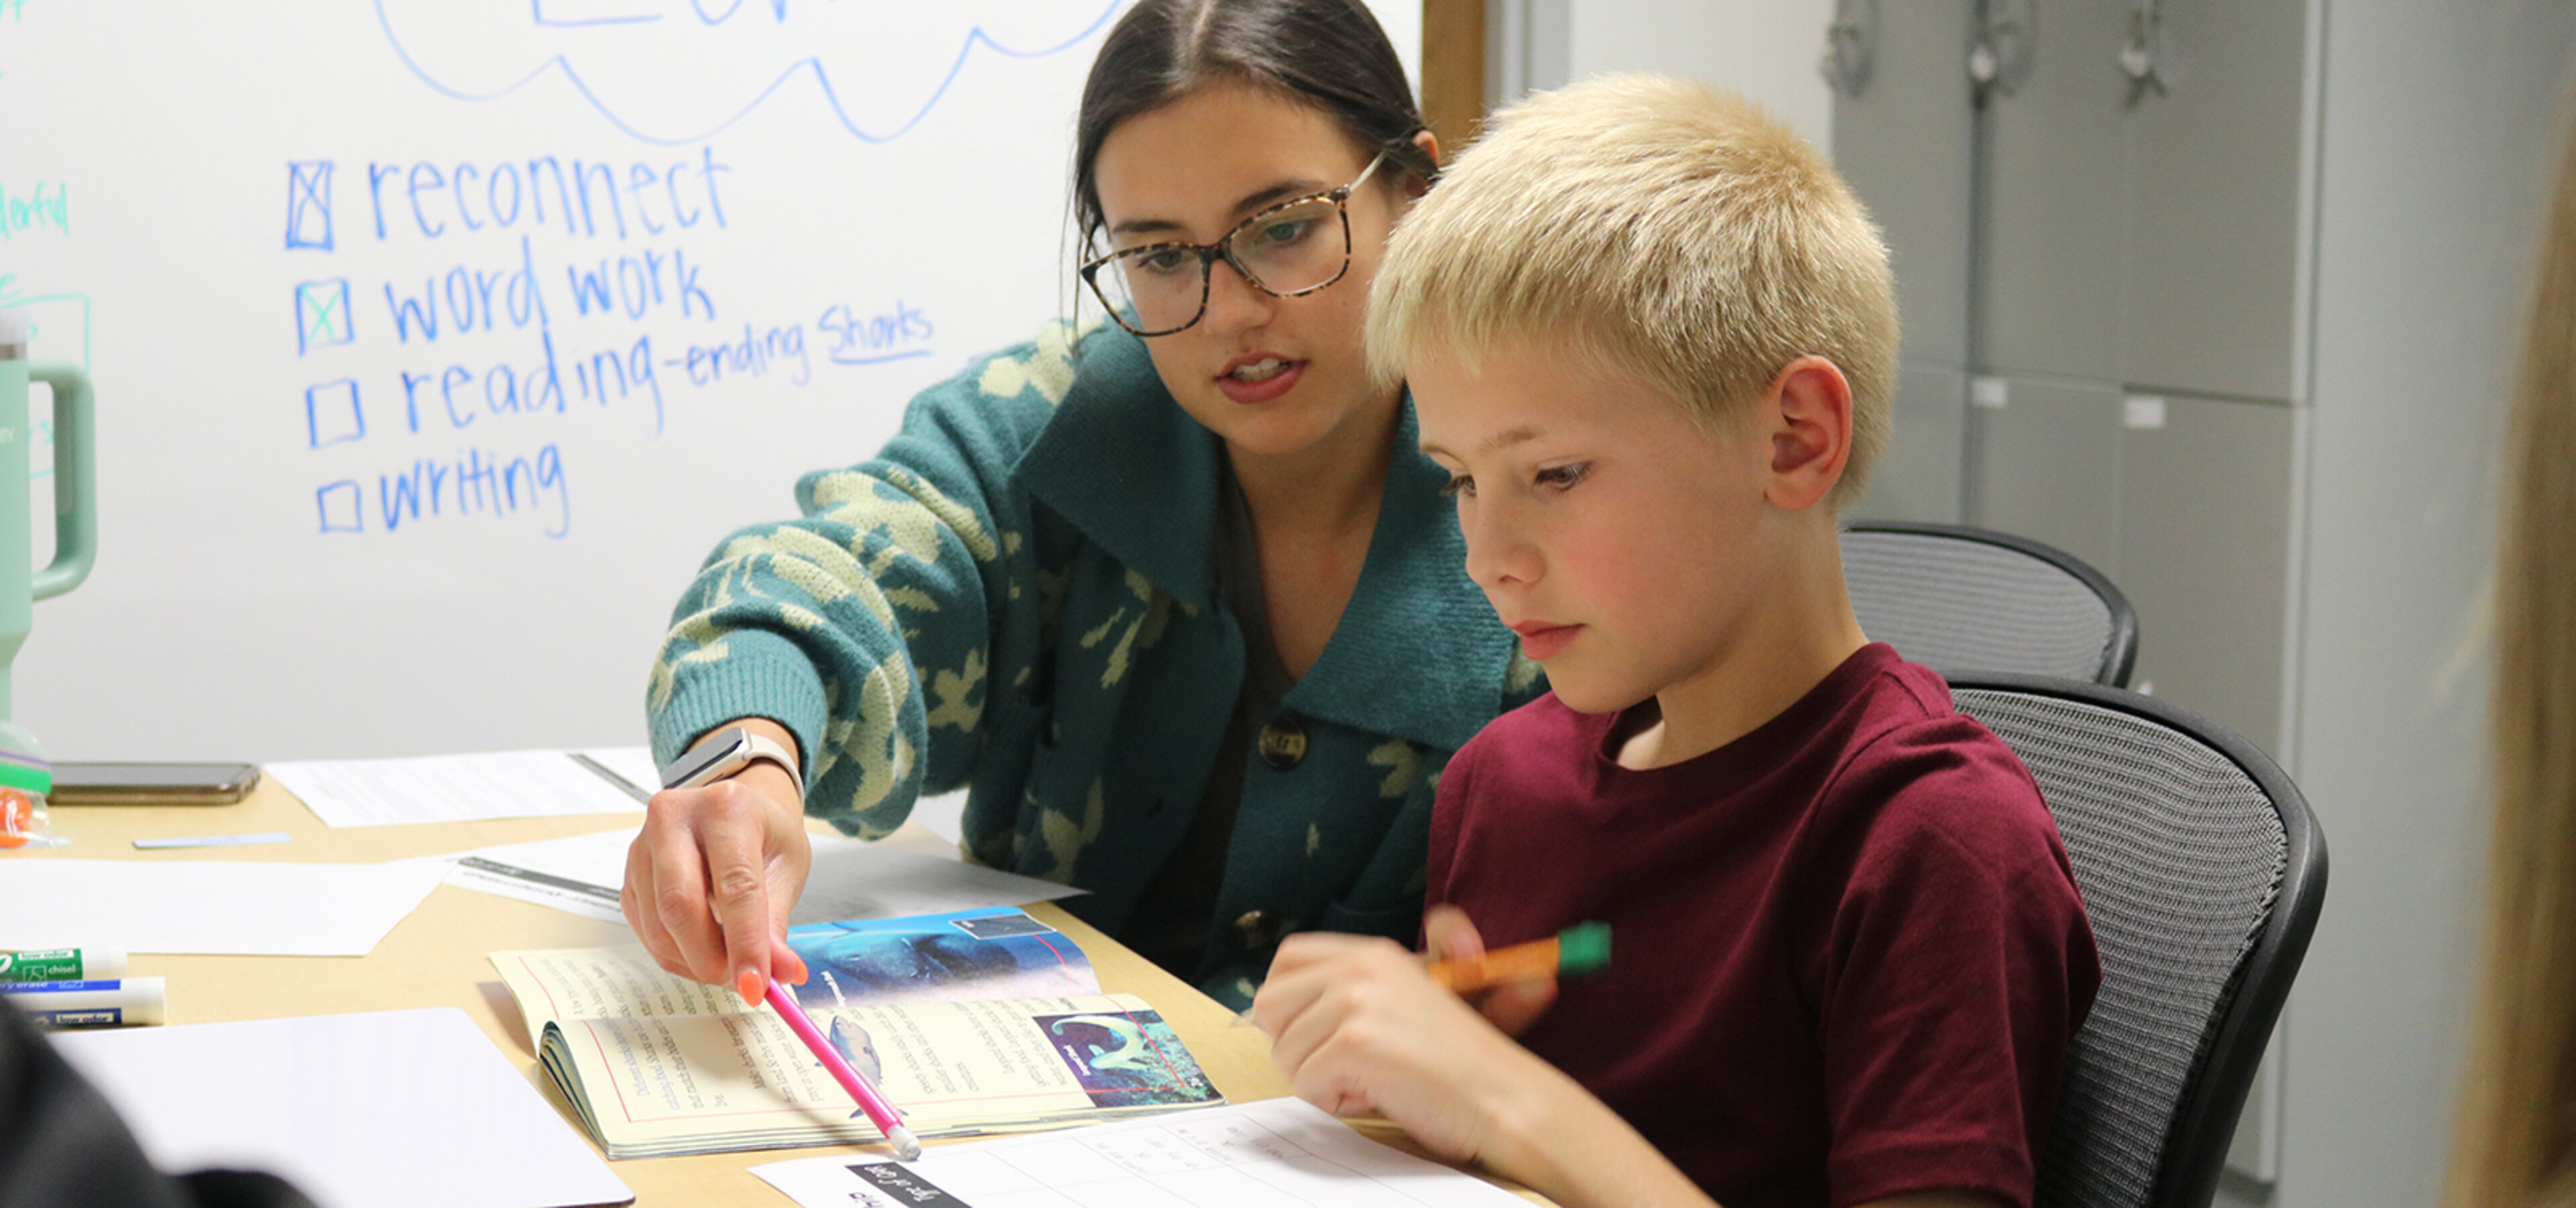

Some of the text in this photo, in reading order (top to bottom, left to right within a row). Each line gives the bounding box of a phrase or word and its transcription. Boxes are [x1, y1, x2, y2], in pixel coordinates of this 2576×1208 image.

[368, 146, 732, 240] reconnect
[384, 235, 716, 344] word work
[818, 299, 934, 353] Sharks
[380, 443, 571, 540] writing
[22, 950, 68, 960] low odor
[48, 964, 76, 974] chisel
[60, 1014, 109, 1024] low odor
